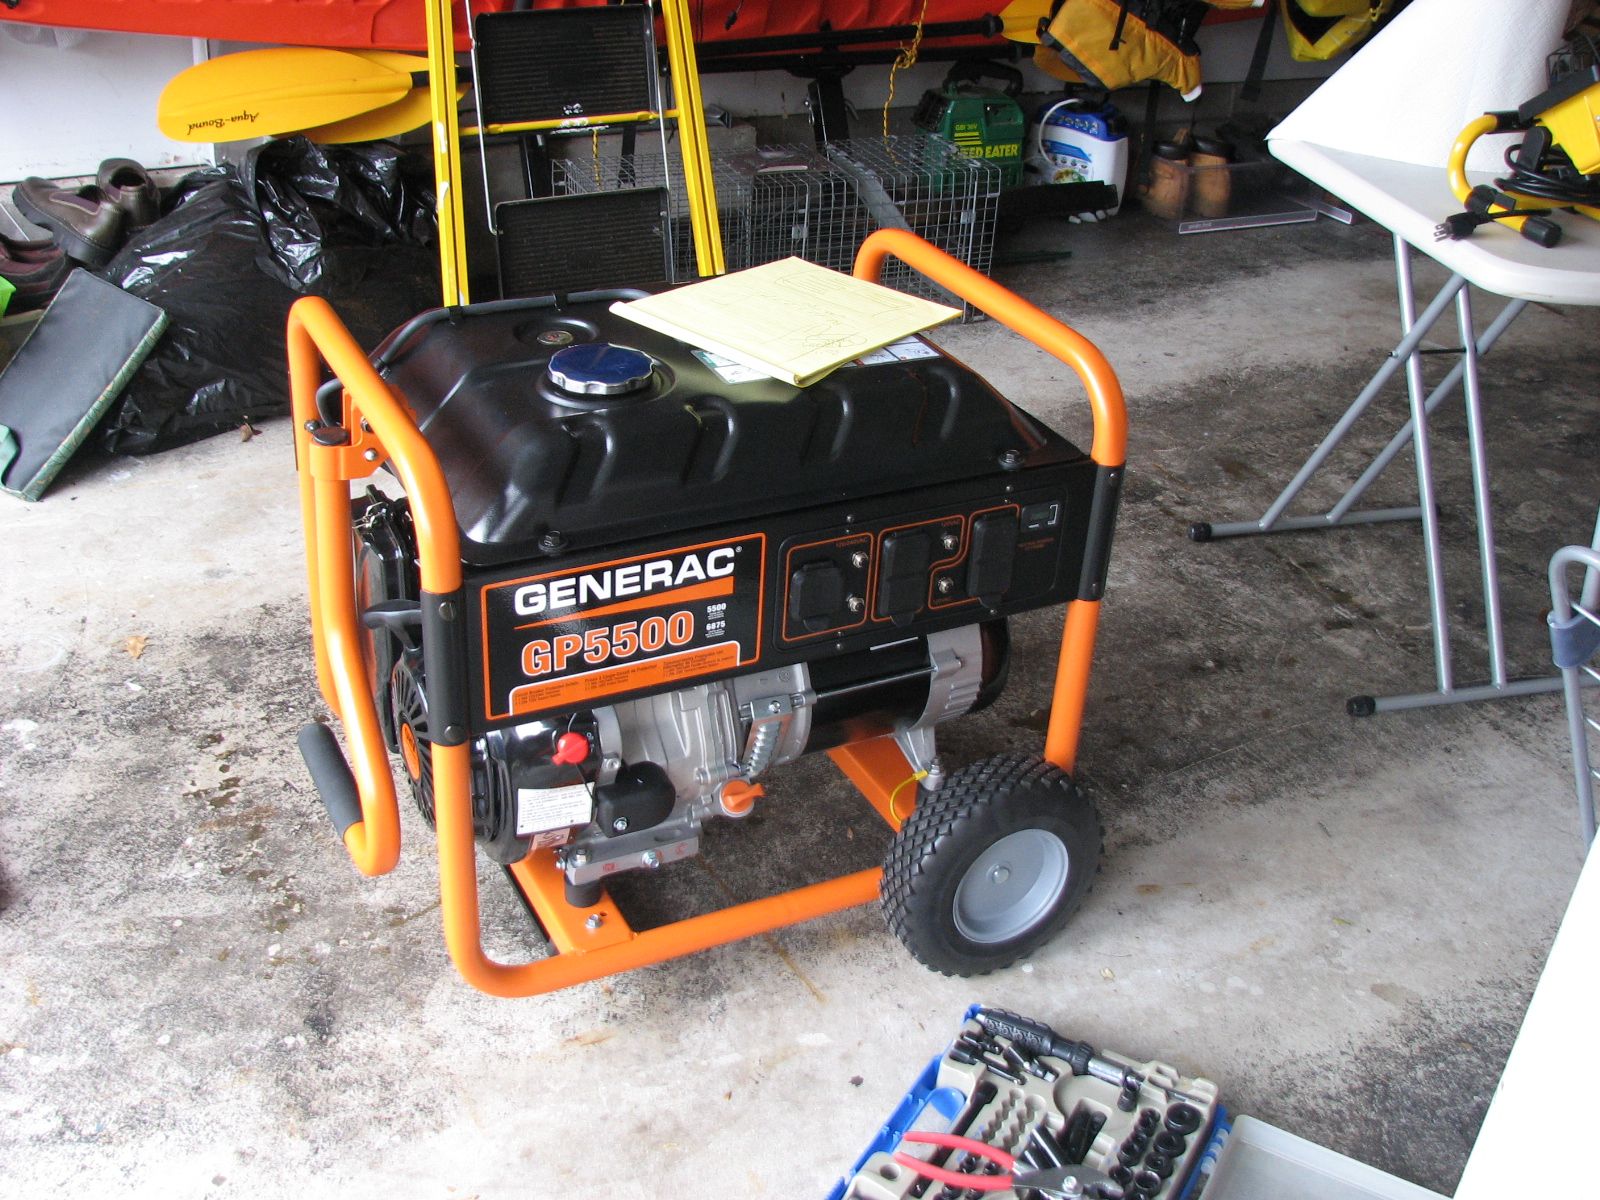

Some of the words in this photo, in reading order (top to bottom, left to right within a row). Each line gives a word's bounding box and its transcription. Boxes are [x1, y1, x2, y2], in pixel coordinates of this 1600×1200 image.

[186, 109, 260, 136] Aqua-Bound
[984, 143, 1019, 159] EATER
[514, 547, 736, 617] GENERAC
[706, 602, 727, 613] 5500
[705, 620, 726, 631] 6875
[521, 610, 695, 677] GP5500
